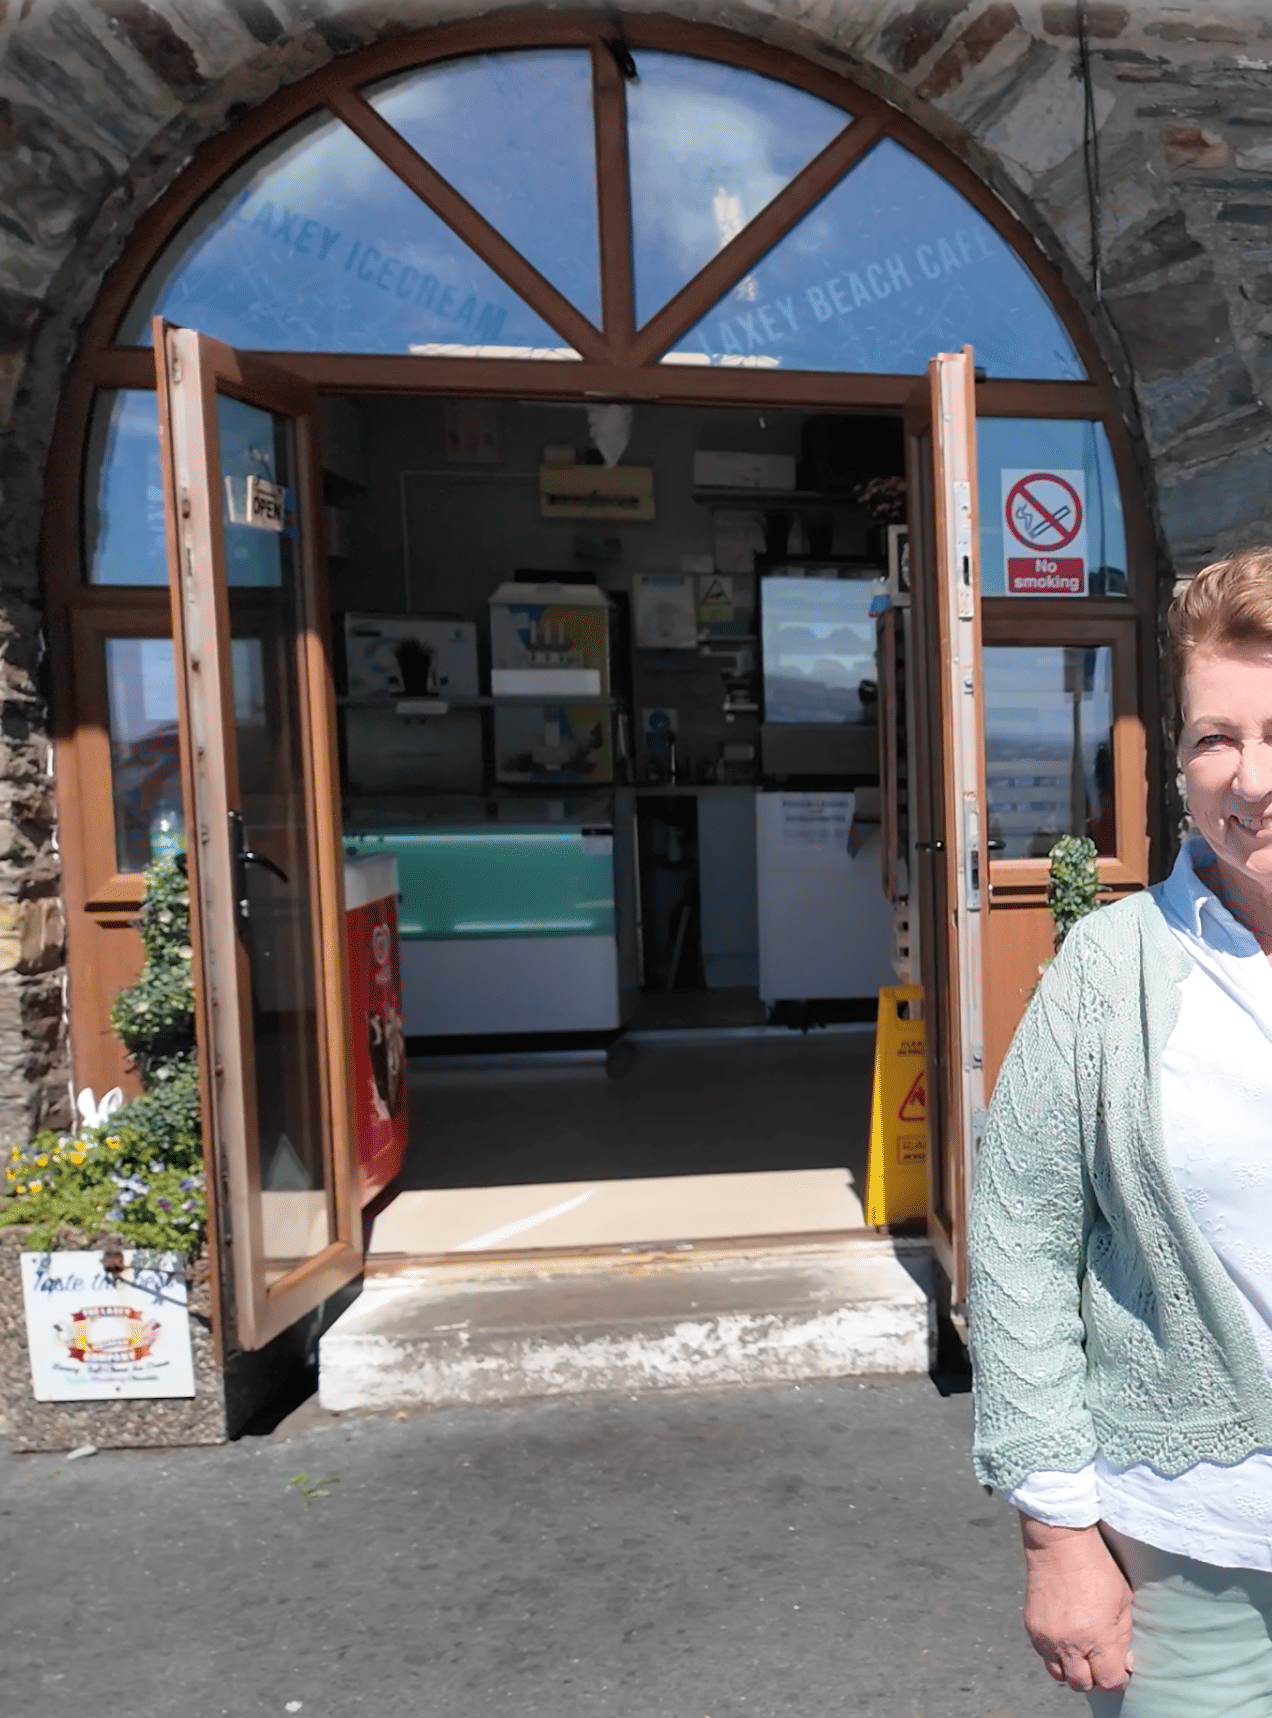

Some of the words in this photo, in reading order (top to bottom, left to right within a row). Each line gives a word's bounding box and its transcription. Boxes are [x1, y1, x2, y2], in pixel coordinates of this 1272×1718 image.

[344, 239, 508, 343] ICECREAM
[699, 297, 800, 355] LAXEY
[806, 253, 914, 323] BEACH
[915, 224, 996, 281] CAFE
[253, 496, 281, 519] OPEN
[1035, 559, 1058, 573] No
[1014, 575, 1080, 592] smoking
